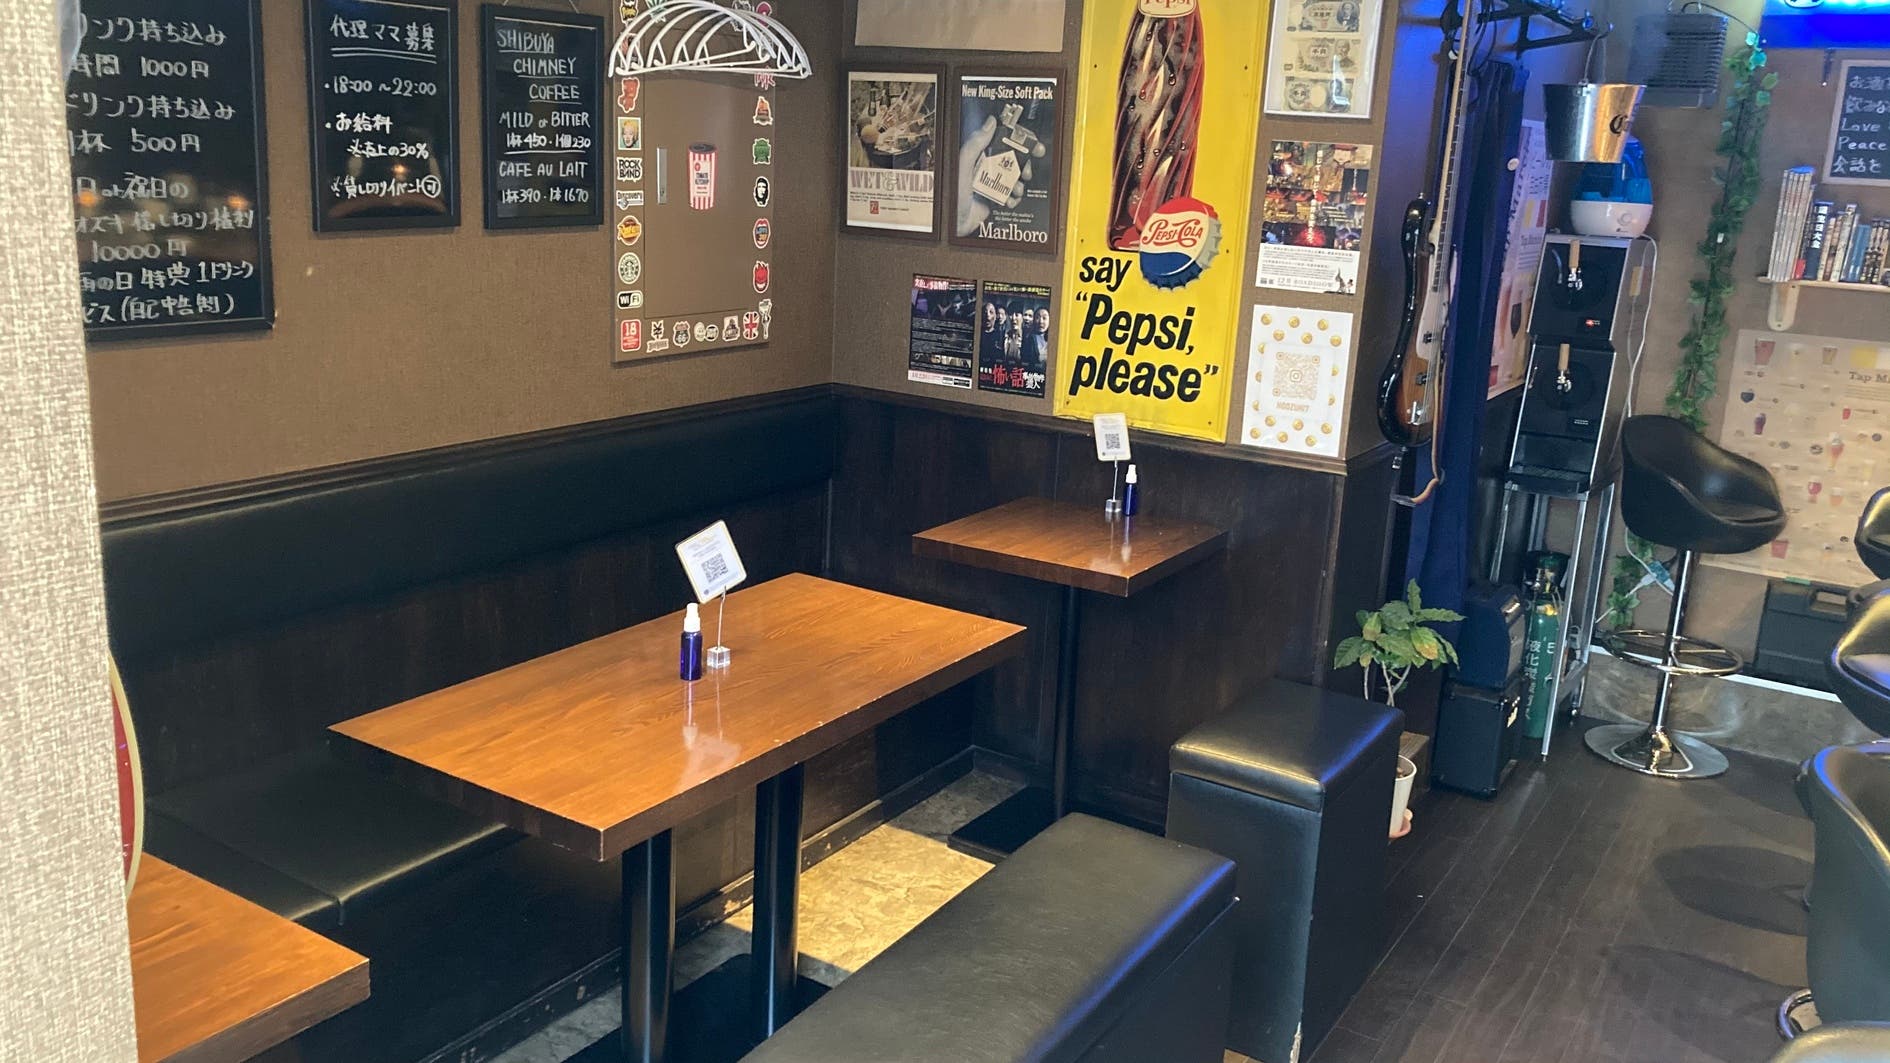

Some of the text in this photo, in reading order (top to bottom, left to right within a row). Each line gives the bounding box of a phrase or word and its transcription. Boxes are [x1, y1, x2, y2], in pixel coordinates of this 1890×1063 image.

[497, 29, 555, 54] SHIBUYA
[141, 56, 209, 78] 1000円
[513, 56, 577, 76] CHIMNEY
[529, 83, 580, 101] COFFEE
[962, 84, 1054, 100] New King-Size Soft Pack
[335, 111, 394, 135] お給料
[499, 111, 534, 128] MILD
[552, 111, 591, 128] BITTER
[1841, 118, 1881, 132] Love
[131, 128, 200, 153] 500円
[1838, 136, 1888, 151] Peace
[499, 161, 589, 179] CAFE AU LAIT
[619, 159, 641, 169] ROCK
[620, 169, 641, 178] BAND
[980, 170, 1011, 196] Marlboro
[979, 222, 1048, 244] Marlboro
[1079, 256, 1133, 292] say
[624, 322, 637, 337] 18
[1849, 371, 1872, 383] Tap
